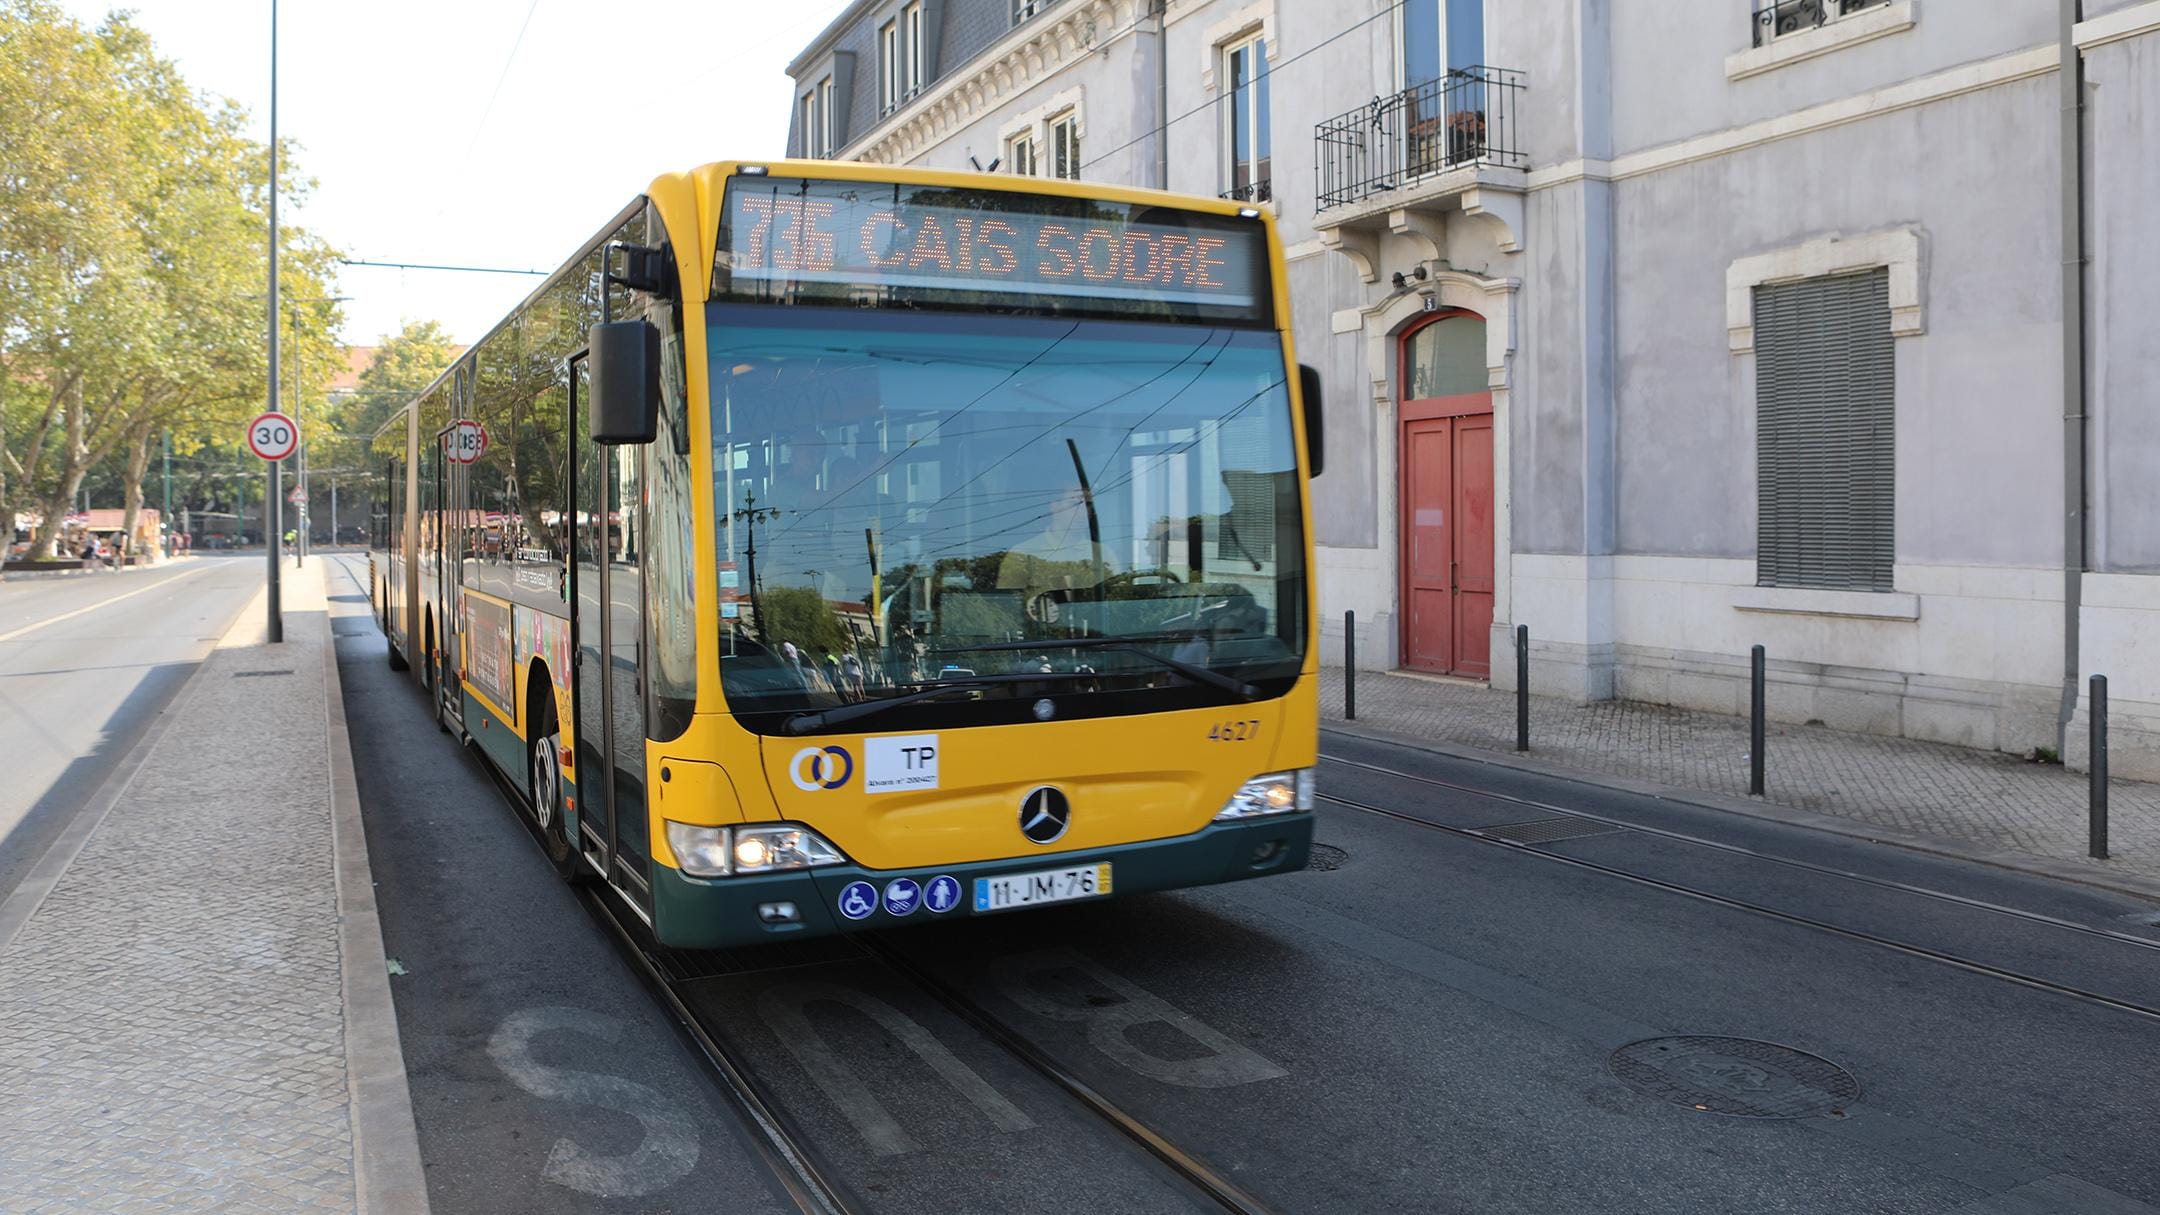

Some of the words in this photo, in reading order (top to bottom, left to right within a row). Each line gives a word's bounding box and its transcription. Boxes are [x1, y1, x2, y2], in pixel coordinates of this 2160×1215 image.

[740, 196, 834, 273] 736
[860, 211, 1018, 277] CAIS
[1039, 223, 1227, 289] SODRE
[256, 426, 289, 446] 30
[1207, 719, 1260, 742] 4627
[901, 746, 936, 770] TP
[992, 869, 1095, 906] 11-JM-76
